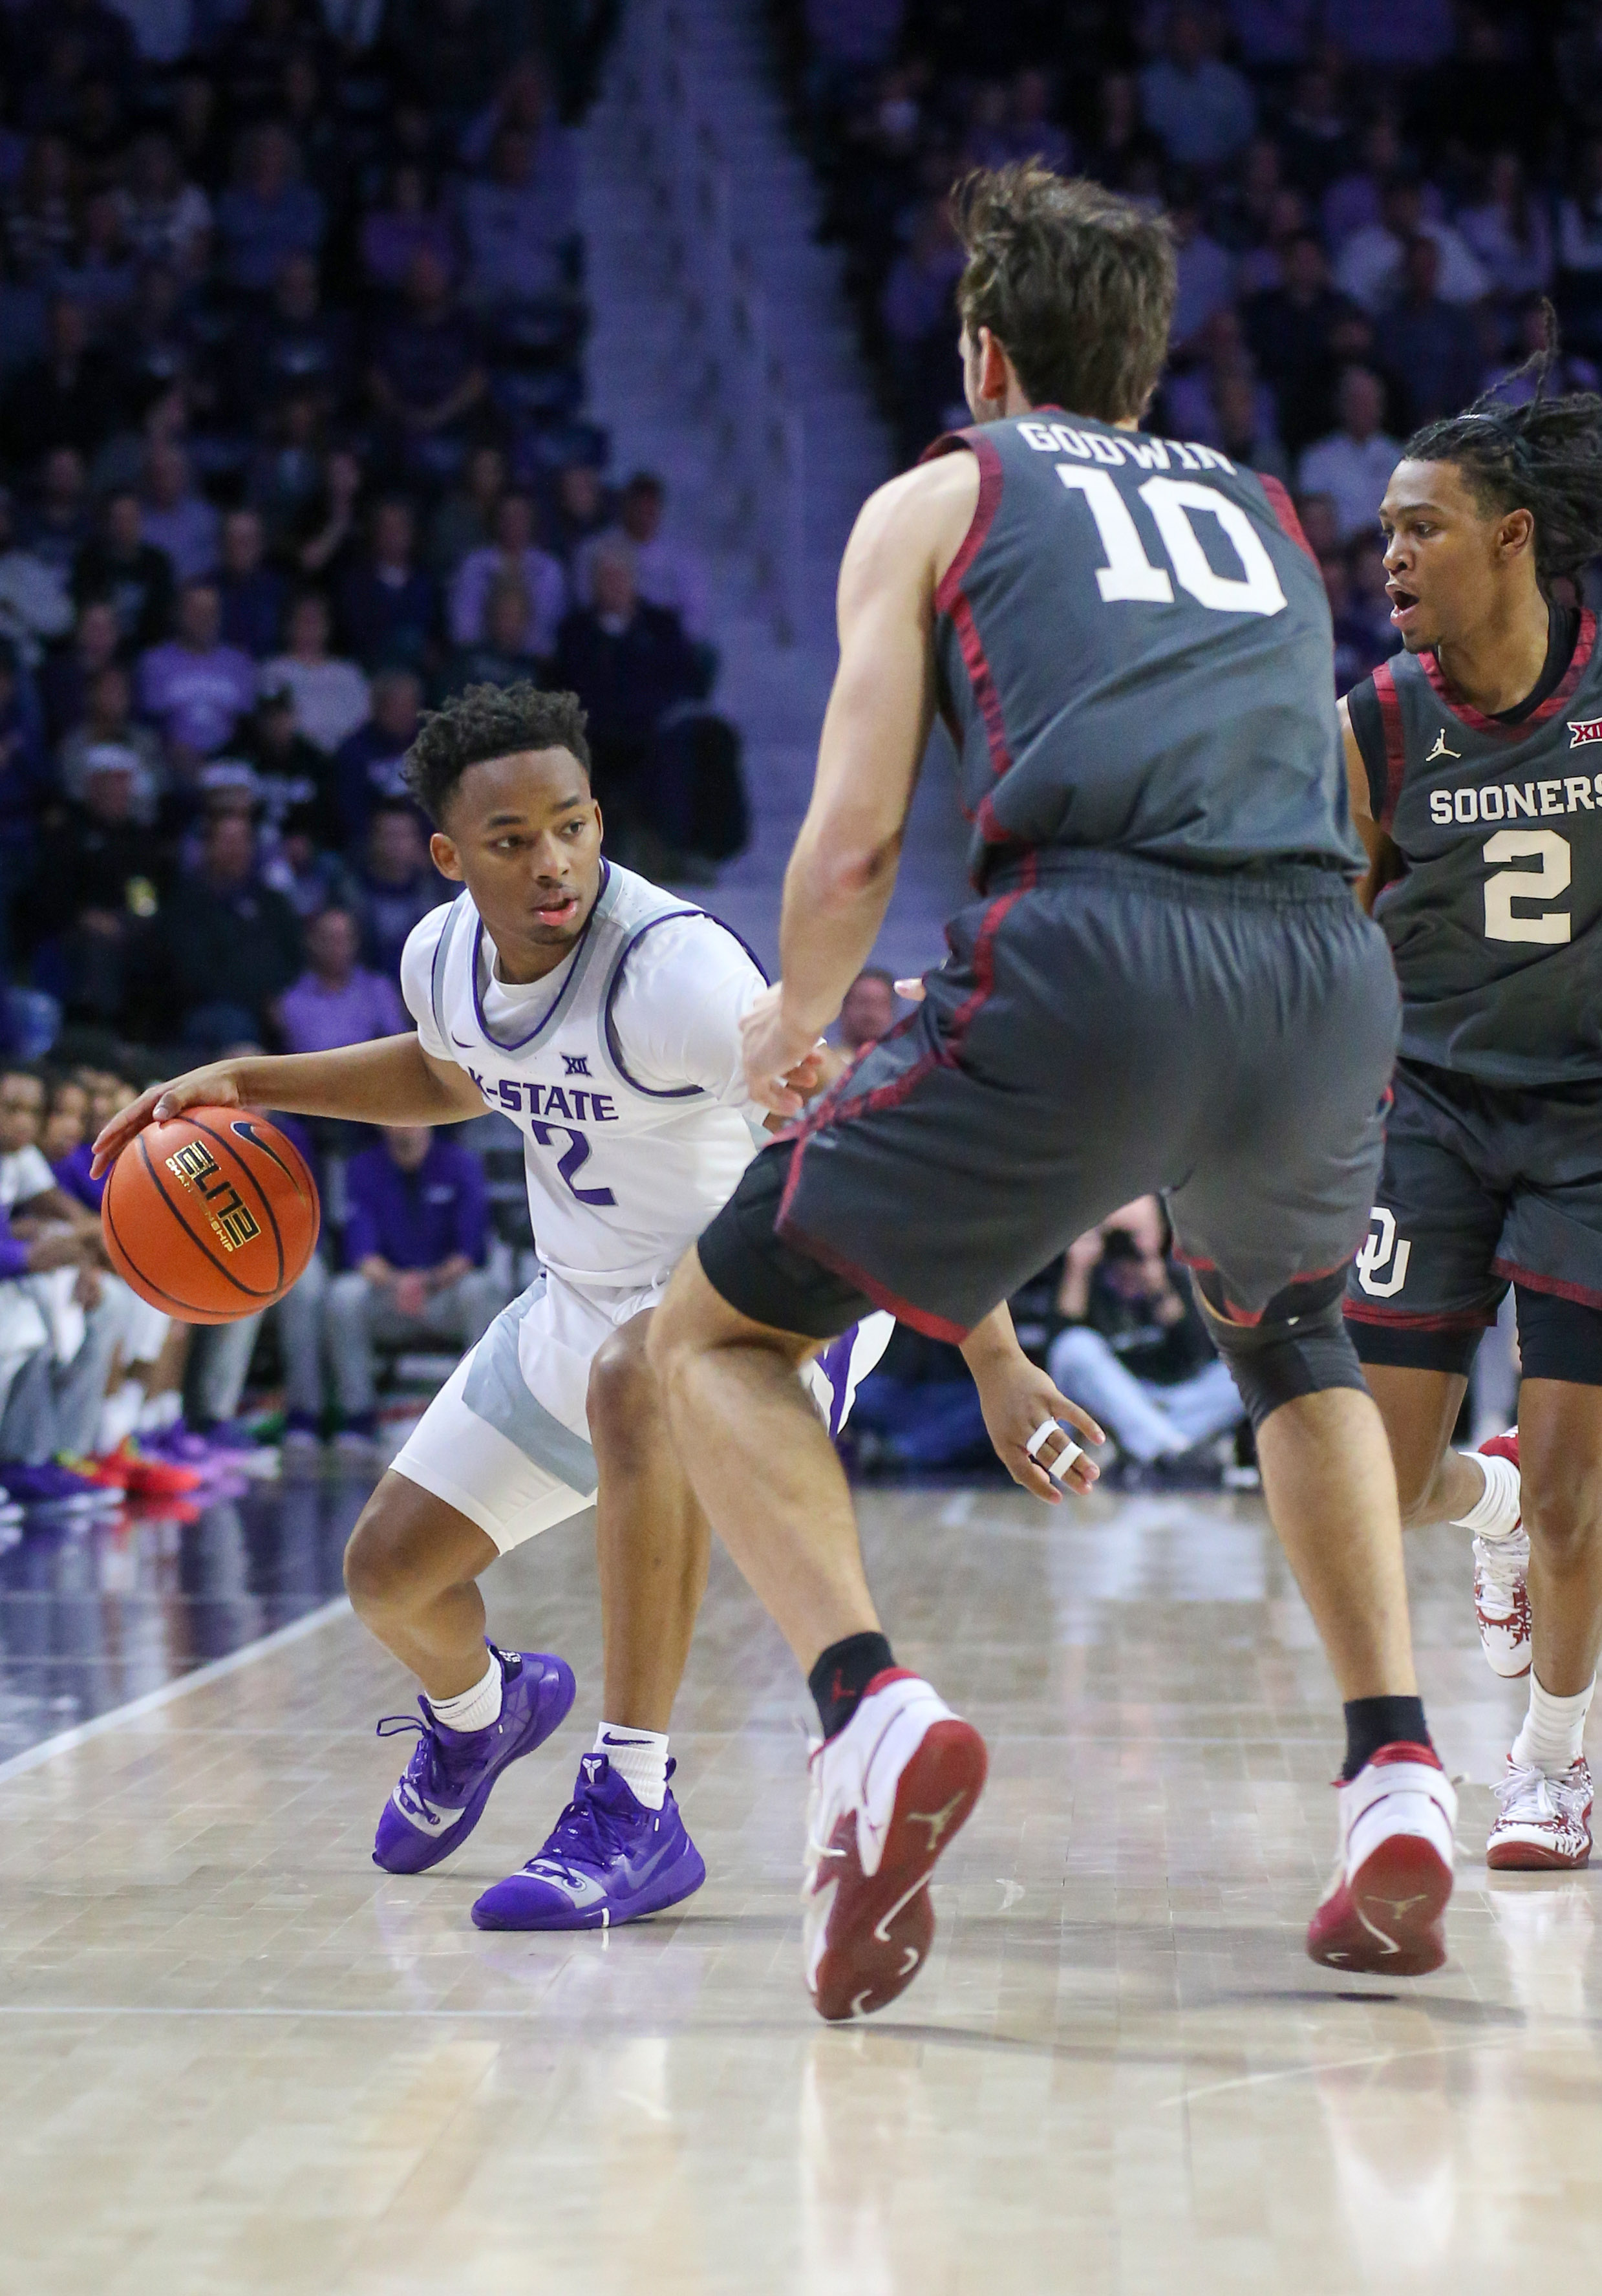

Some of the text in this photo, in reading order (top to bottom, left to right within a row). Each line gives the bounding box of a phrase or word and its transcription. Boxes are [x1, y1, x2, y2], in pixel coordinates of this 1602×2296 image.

[1016, 422, 1237, 476] GODWIN
[1054, 463, 1288, 617] 10
[1483, 829, 1572, 945] 2
[165, 1157, 234, 1252] CHAONSHIP
[173, 1140, 262, 1249] ELITE
[531, 1119, 618, 1206] 2
